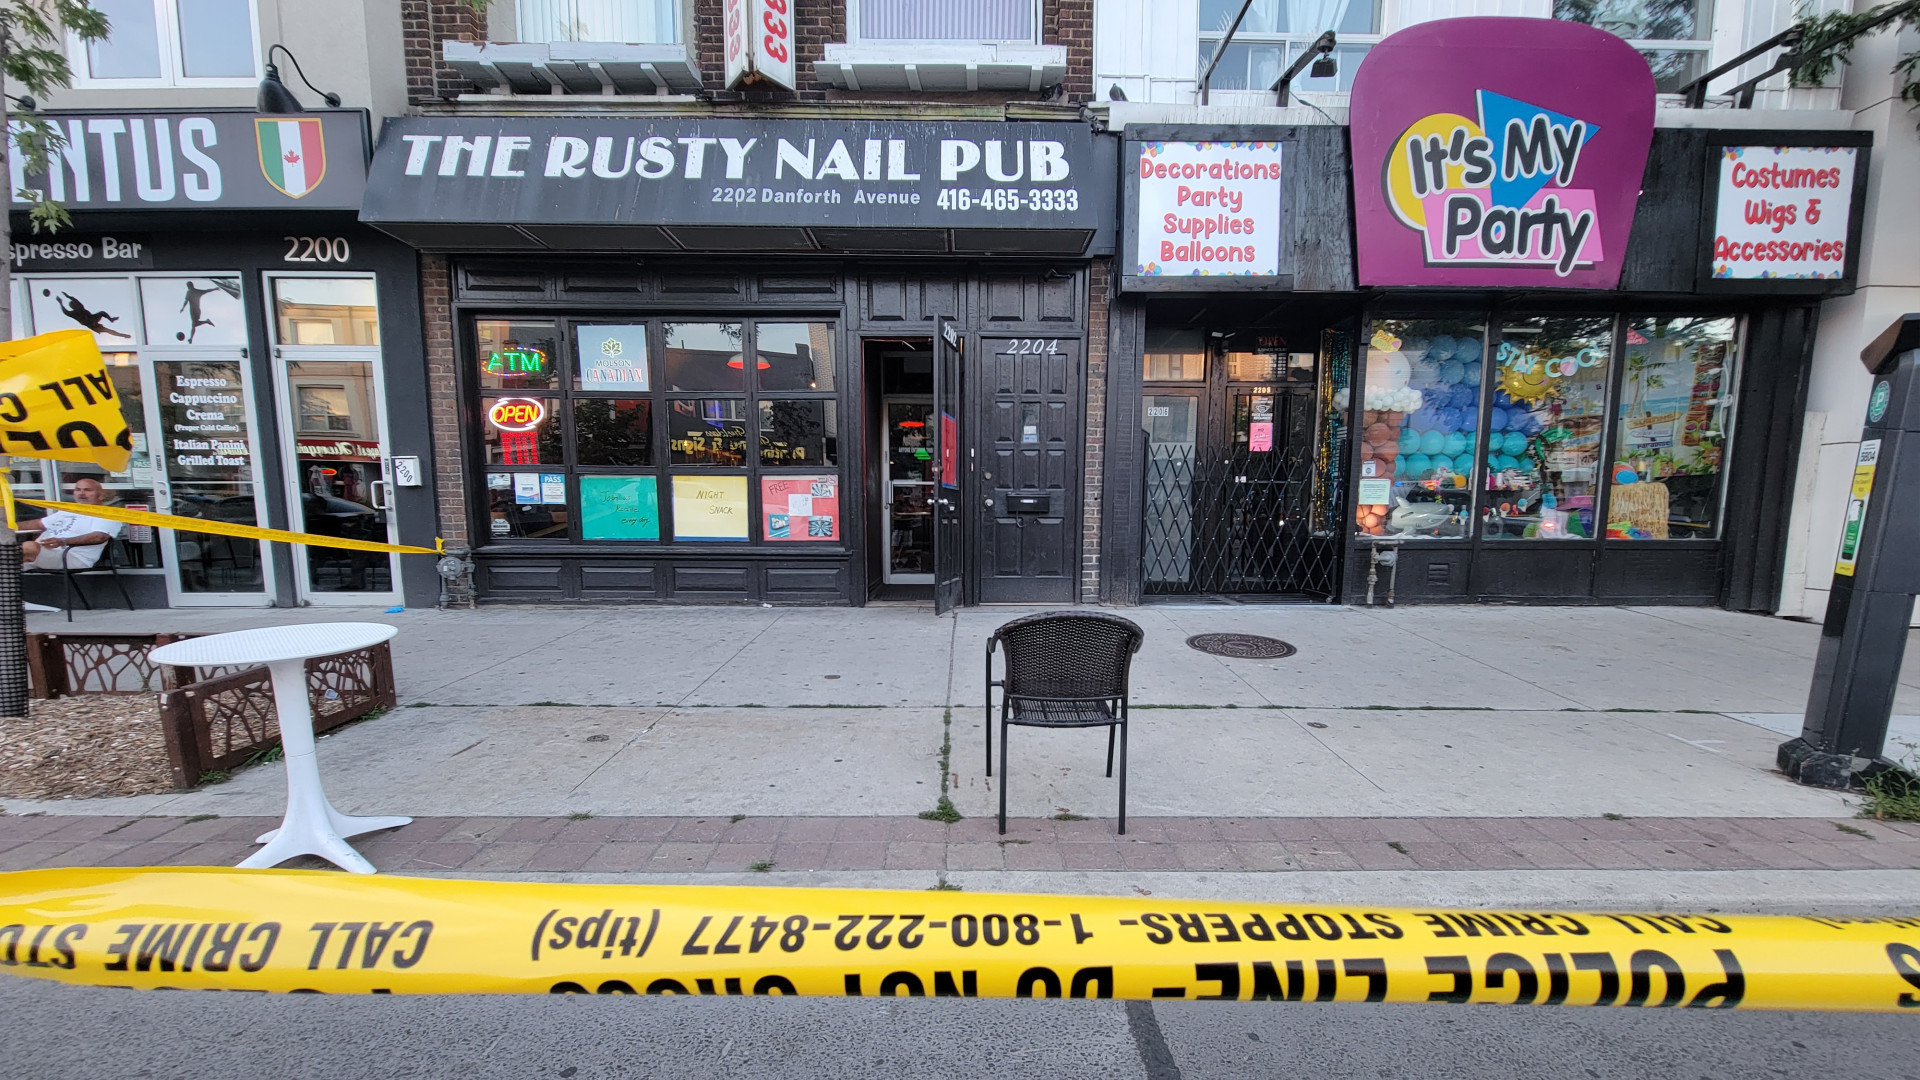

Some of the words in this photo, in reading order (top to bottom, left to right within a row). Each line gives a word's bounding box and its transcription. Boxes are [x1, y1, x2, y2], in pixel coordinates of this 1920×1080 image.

[402, 134, 531, 177] THE
[544, 135, 757, 179] RUSTY
[775, 137, 921, 181] NAIL
[940, 138, 1070, 182] PUB
[1407, 128, 1494, 196] It's
[1503, 115, 1584, 186] My
[1140, 157, 1281, 179] Decorations
[1732, 162, 1840, 189] Costumes
[711, 187, 756, 204] 2202
[761, 188, 841, 204] Danforth
[854, 189, 921, 205] Avenue
[937, 188, 1079, 211] 416-465-3333
[1177, 185, 1243, 213] Party
[1163, 213, 1255, 239] Supplies
[1744, 199, 1797, 233] Wigs
[1805, 198, 1821, 225] &
[1443, 195, 1593, 275] Party
[102, 236, 142, 259] Bar
[284, 236, 350, 263] 2200
[1160, 240, 1256, 263] Balloons
[1713, 235, 1844, 262] Accessories
[1006, 339, 1059, 355] 2204
[1496, 342, 1539, 375] STAY
[487, 352, 541, 372] ATM
[595, 360, 631, 368] MOLSON
[175, 375, 227, 389] Espresso
[586, 367, 643, 383] CANADIAN
[169, 392, 238, 406] Cappuccino
[186, 409, 224, 420] Crema
[493, 404, 538, 423] OPEN
[173, 439, 209, 450] Italian
[210, 439, 245, 450] Panini
[177, 454, 215, 466] Grilled
[215, 454, 245, 466] Toast
[395, 461, 413, 482] 2200
[696, 491, 725, 500] NIGHT
[768, 481, 790, 495] FREE
[709, 505, 734, 515] SNACK
[531, 909, 661, 962] (tips)
[1411, 912, 1590, 938] CRIME
[104, 922, 282, 972] CRIME
[308, 920, 434, 970] CALL
[1424, 949, 1746, 1009] POLICE
